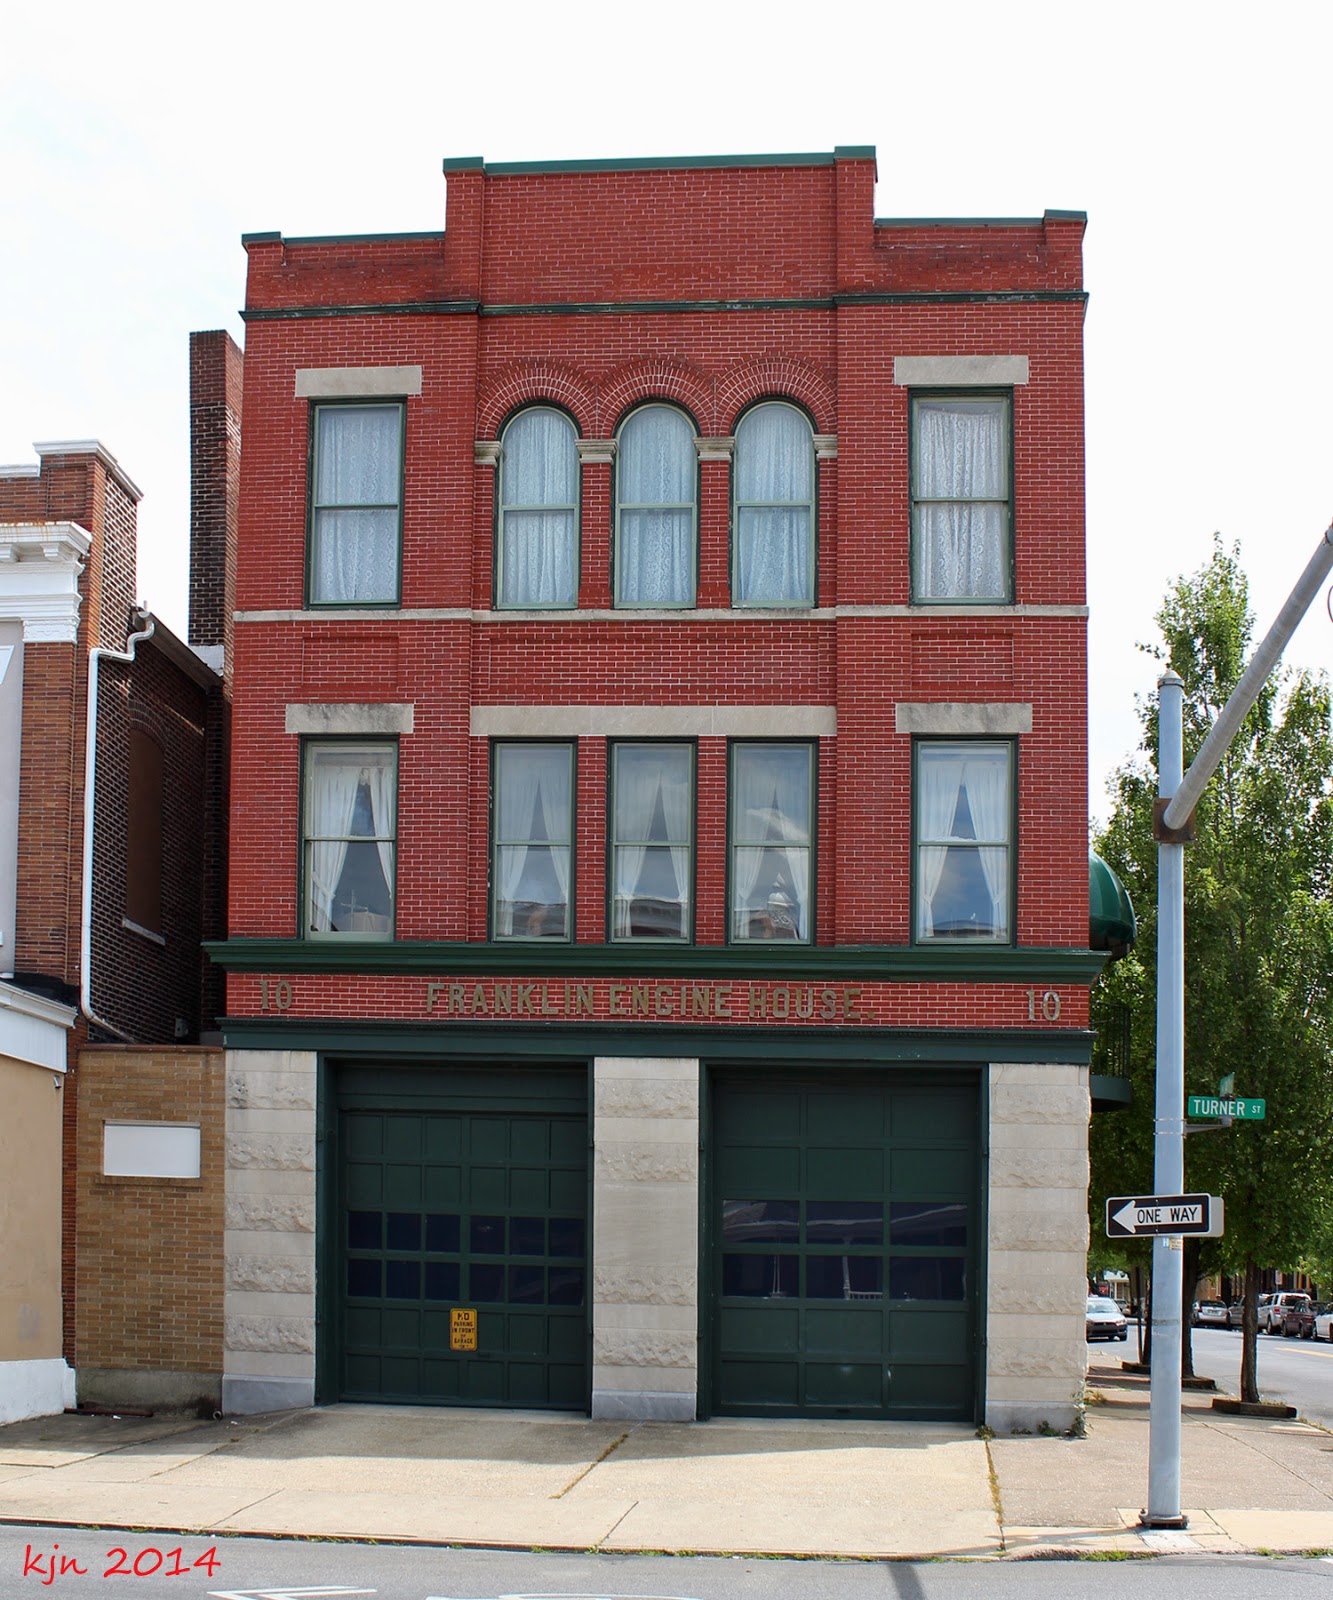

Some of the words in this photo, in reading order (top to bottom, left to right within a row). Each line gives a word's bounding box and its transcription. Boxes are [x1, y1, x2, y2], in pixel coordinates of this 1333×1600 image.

[259, 979, 293, 1011] 10
[426, 983, 594, 1015] FRANKLIN
[609, 985, 733, 1017] ENGINE
[1025, 989, 1061, 1022] 10
[1193, 1099, 1246, 1116] TURNER
[1251, 1105, 1262, 1114] ST
[1136, 1208, 1161, 1224] ONE
[1170, 1206, 1198, 1223] WAY
[457, 1312, 470, 1321] NO
